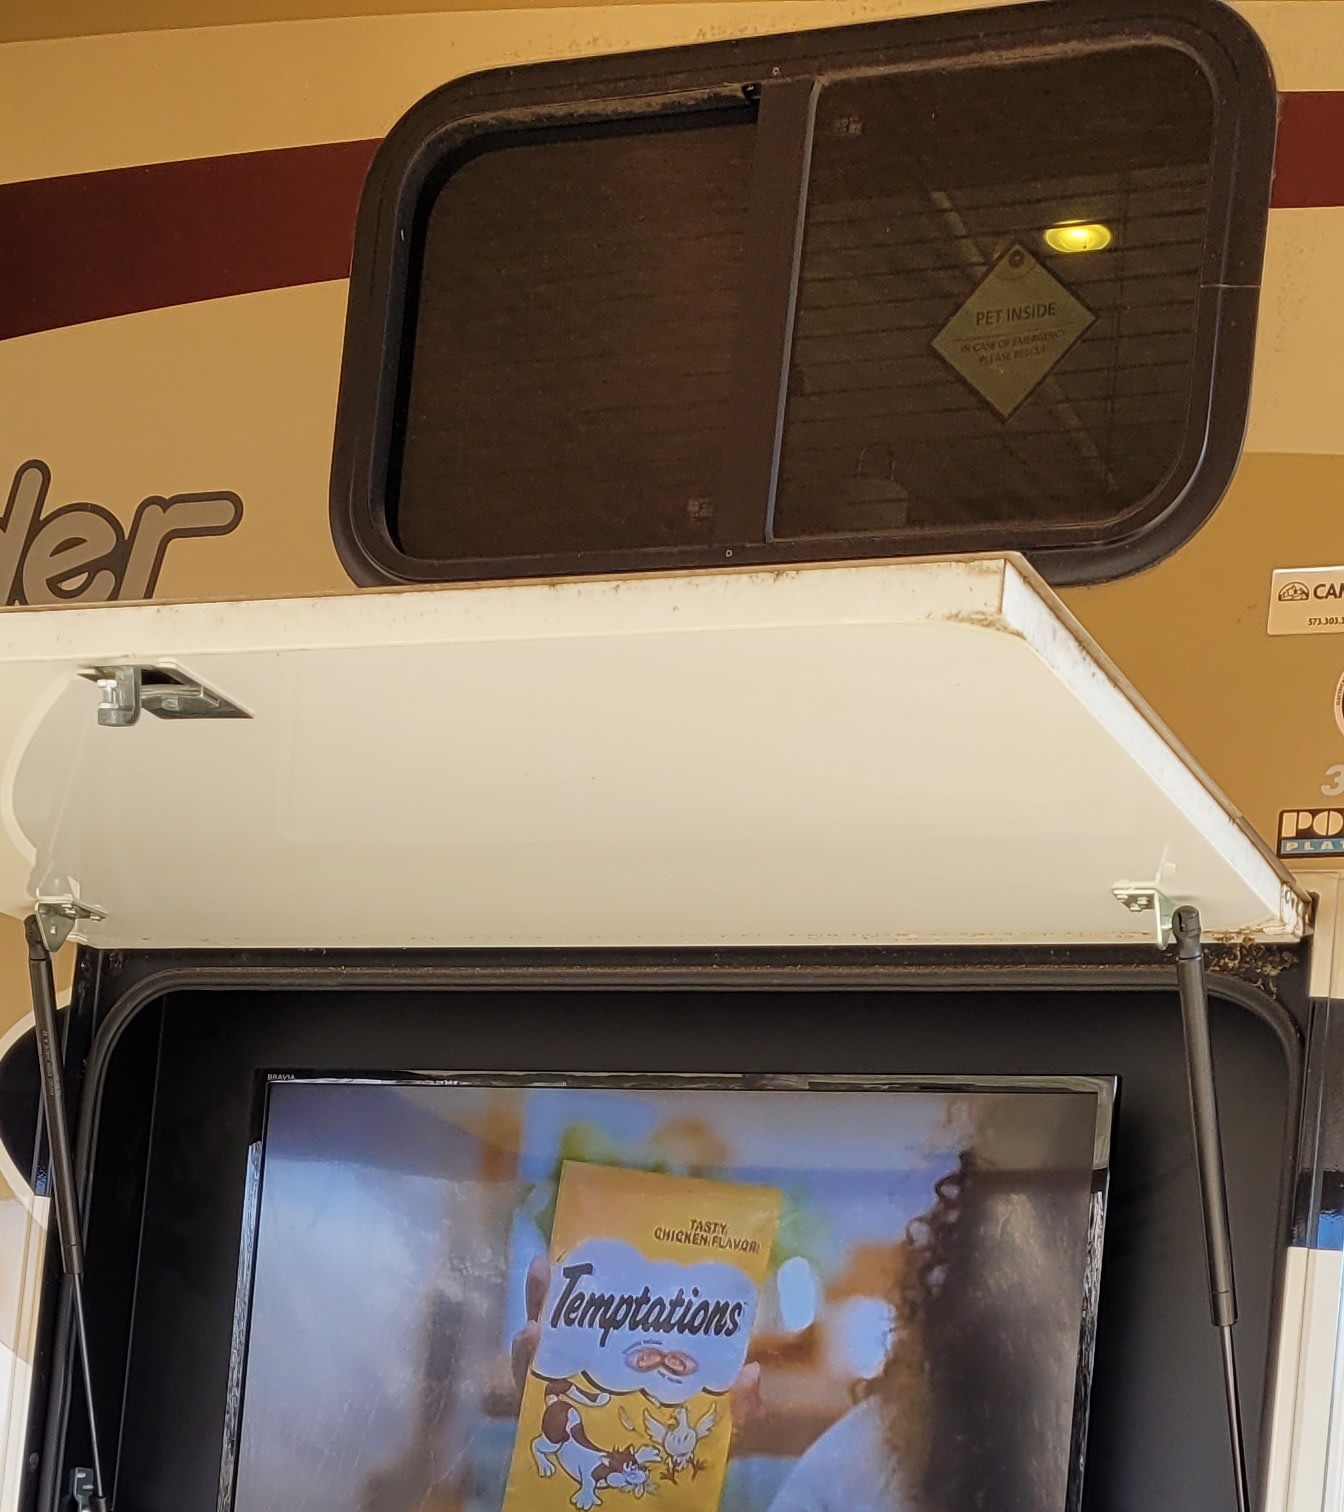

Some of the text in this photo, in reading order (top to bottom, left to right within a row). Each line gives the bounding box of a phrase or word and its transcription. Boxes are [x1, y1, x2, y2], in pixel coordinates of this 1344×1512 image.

[976, 302, 1056, 326] PET INSIDE
[654, 1227, 708, 1247] CHICKEN
[690, 1219, 727, 1235] TASTY
[550, 1262, 744, 1347] Temptations
